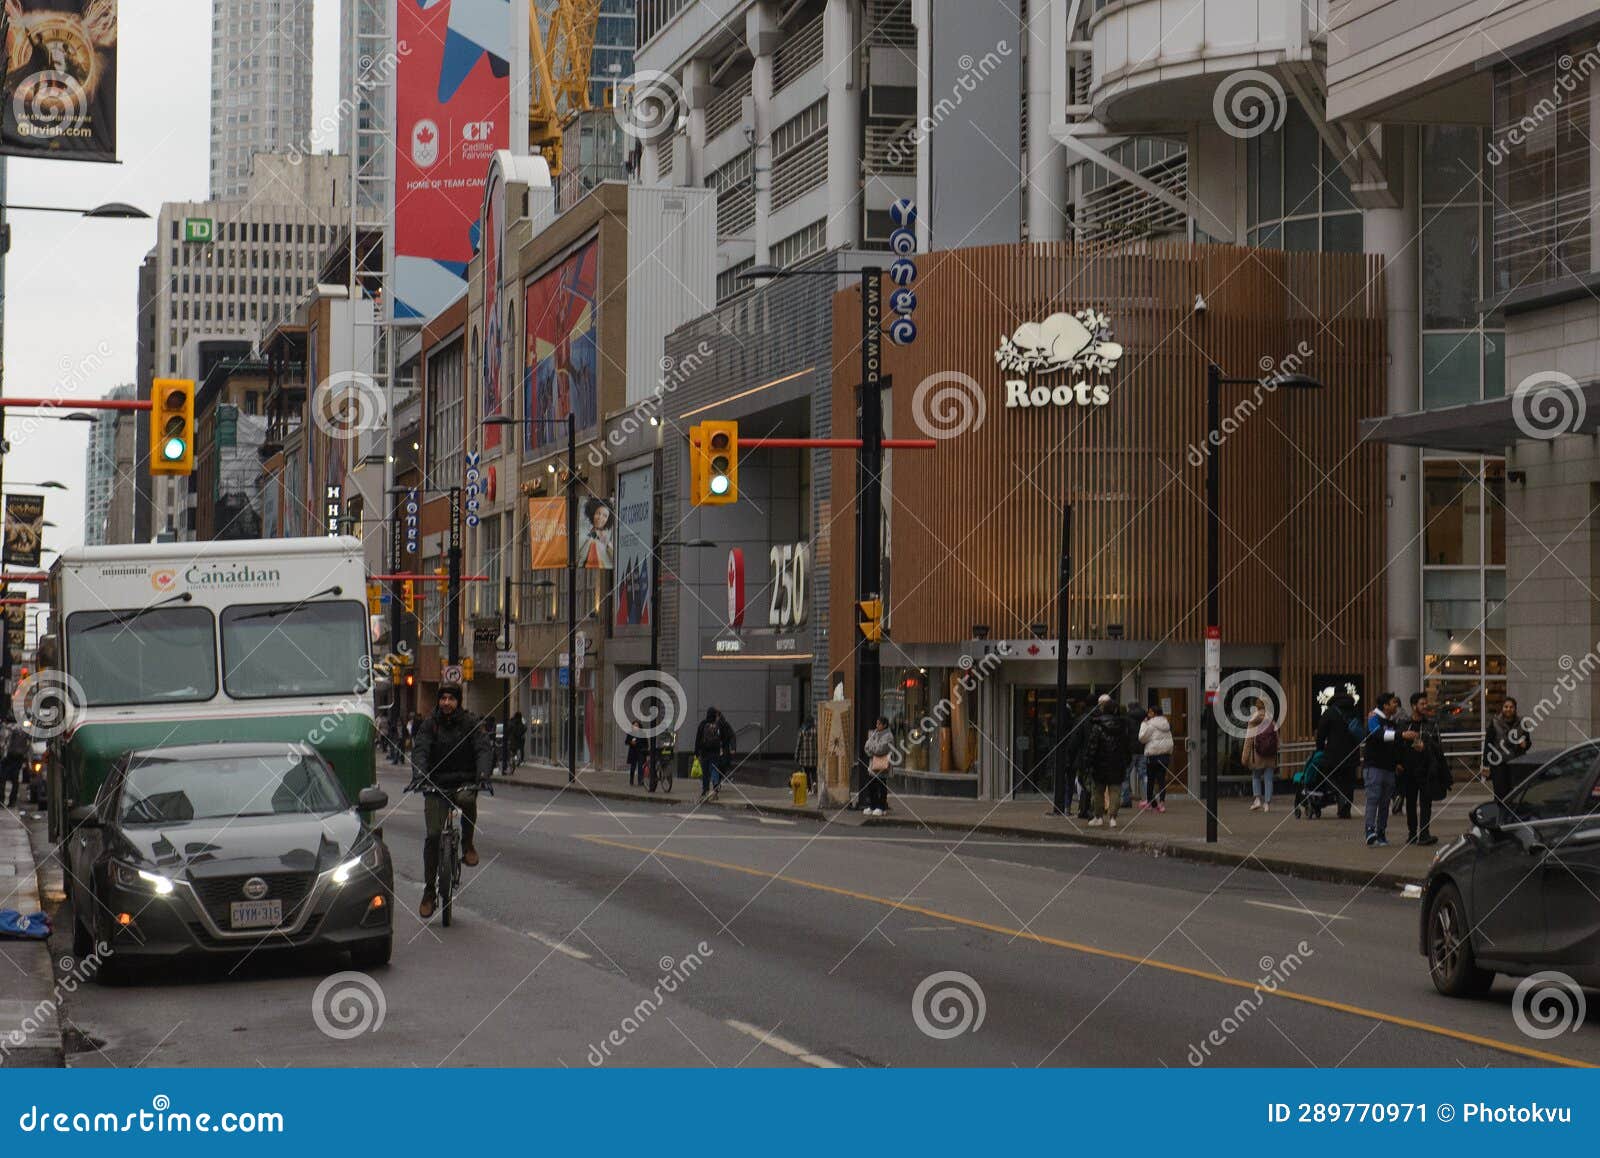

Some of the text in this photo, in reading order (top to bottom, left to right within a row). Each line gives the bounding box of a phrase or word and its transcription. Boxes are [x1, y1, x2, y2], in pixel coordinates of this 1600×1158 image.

[462, 121, 494, 140] CF
[462, 143, 493, 151] Cadillac
[407, 180, 429, 190] HOME
[431, 180, 441, 189] OF
[444, 179, 465, 188] TEAM
[187, 222, 210, 237] TD
[868, 275, 879, 382] DOWNTOWN
[1005, 380, 1110, 408] Roots
[185, 566, 280, 584] Canadian
[769, 543, 806, 626] 250
[498, 662, 516, 674] 40
